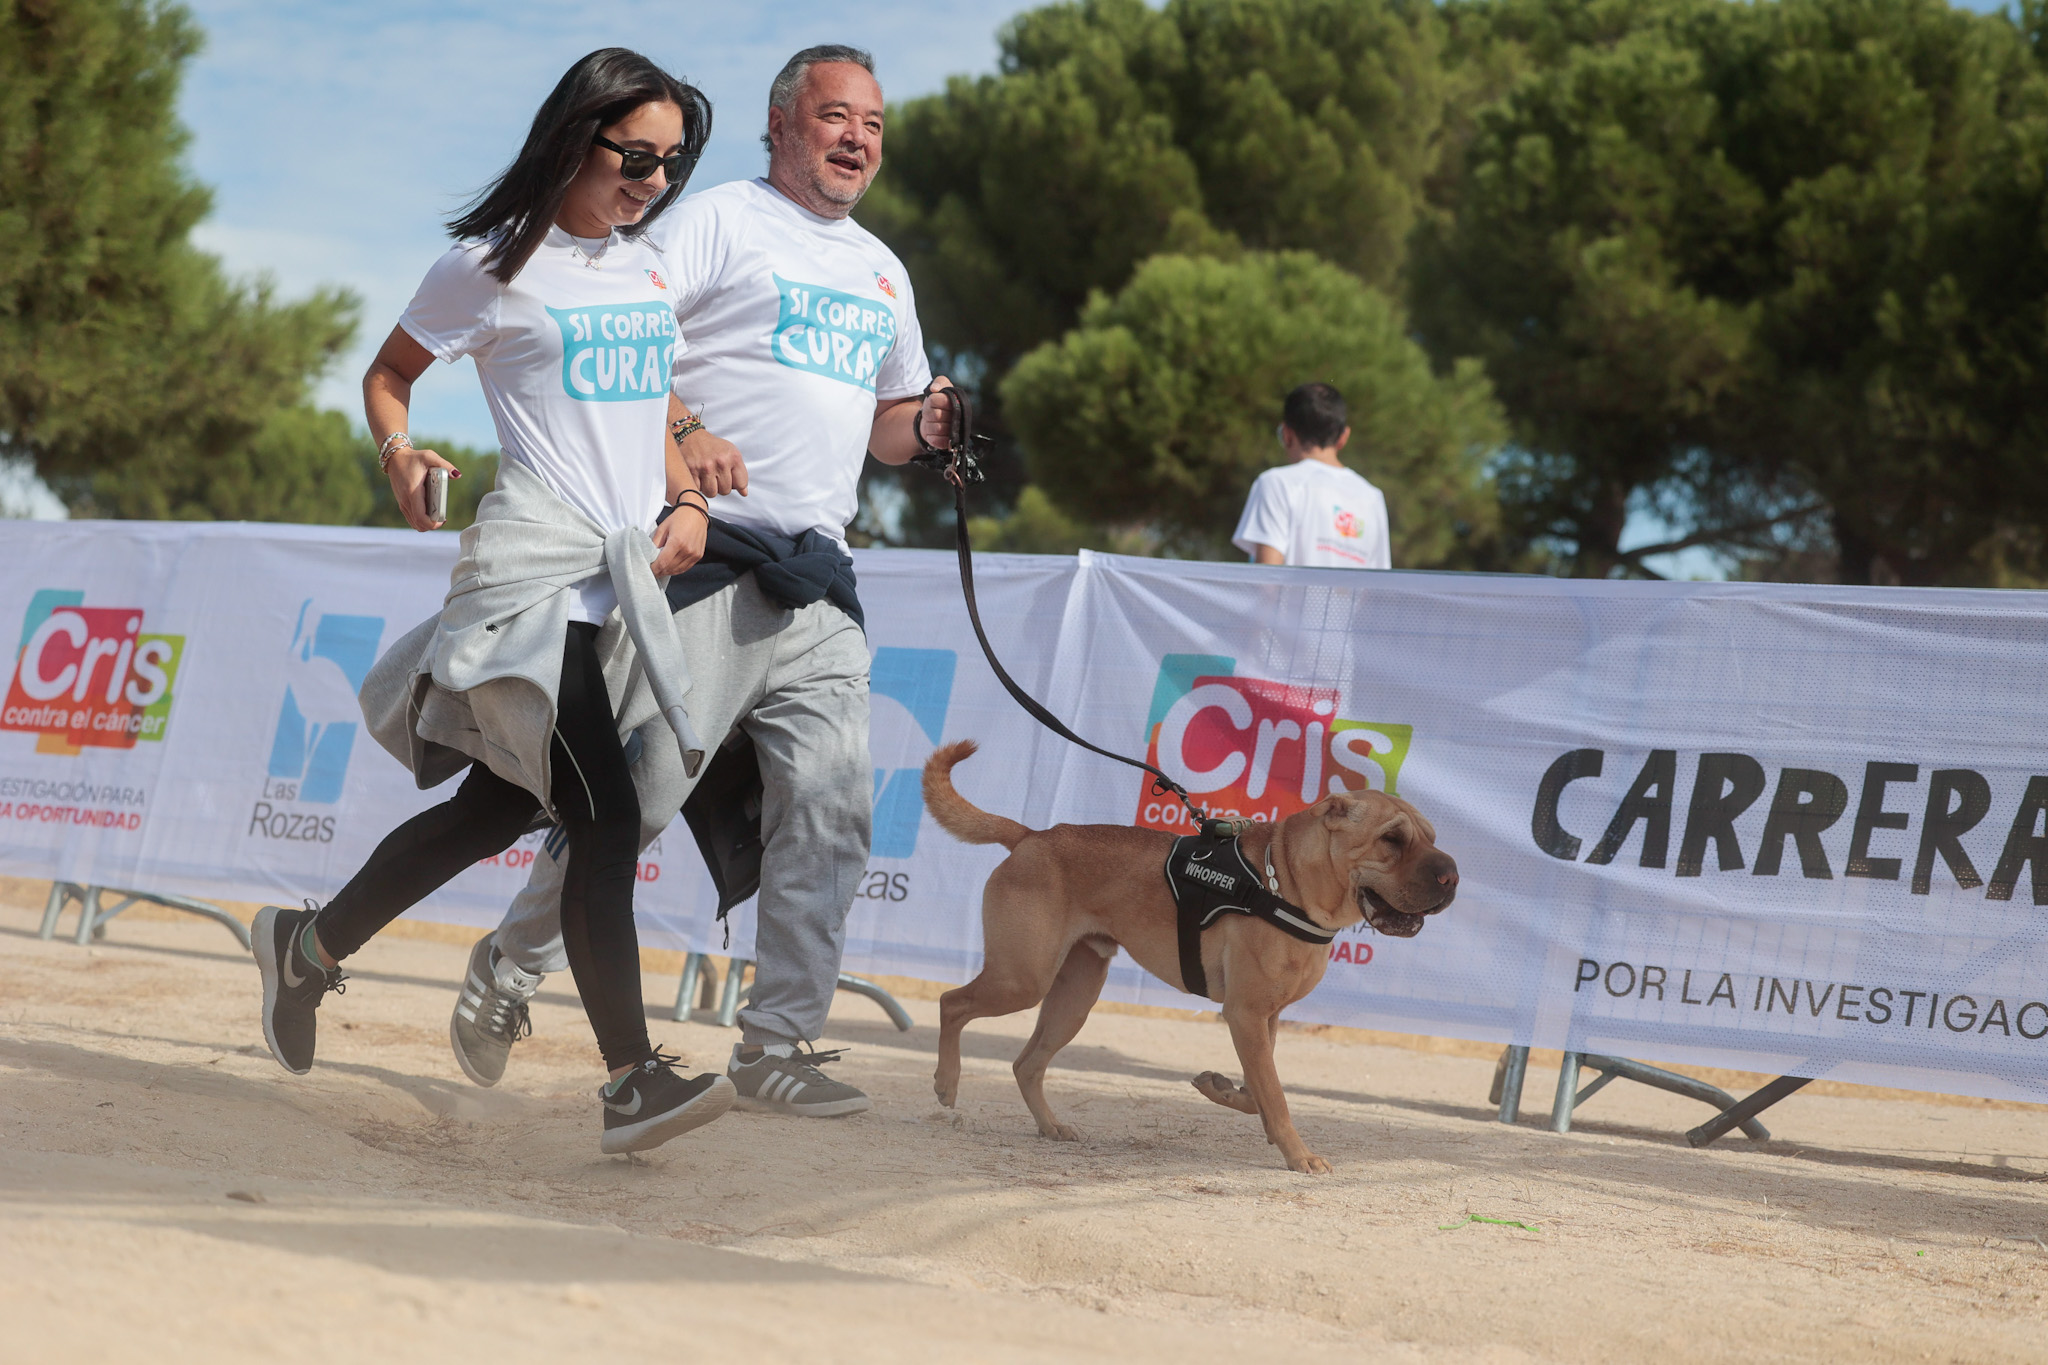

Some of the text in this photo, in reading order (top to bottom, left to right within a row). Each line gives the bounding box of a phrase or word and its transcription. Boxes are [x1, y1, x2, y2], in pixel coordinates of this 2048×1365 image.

[568, 310, 676, 342] SI CORRES
[790, 287, 895, 342] SI CORRES
[570, 343, 674, 395] CURAS
[20, 611, 173, 707] Cris
[4, 705, 165, 734] contra el cáncer
[1157, 683, 1394, 804] Cris
[101, 785, 145, 806] PARA
[263, 776, 298, 801] Las
[16, 803, 141, 831] OPORTUNIDAD
[248, 801, 336, 843] Rozas
[1531, 748, 2048, 906] CARRERA
[1185, 861, 1236, 890] WHOPPER
[1574, 958, 2048, 1040] POR LA INVESTIGAC
